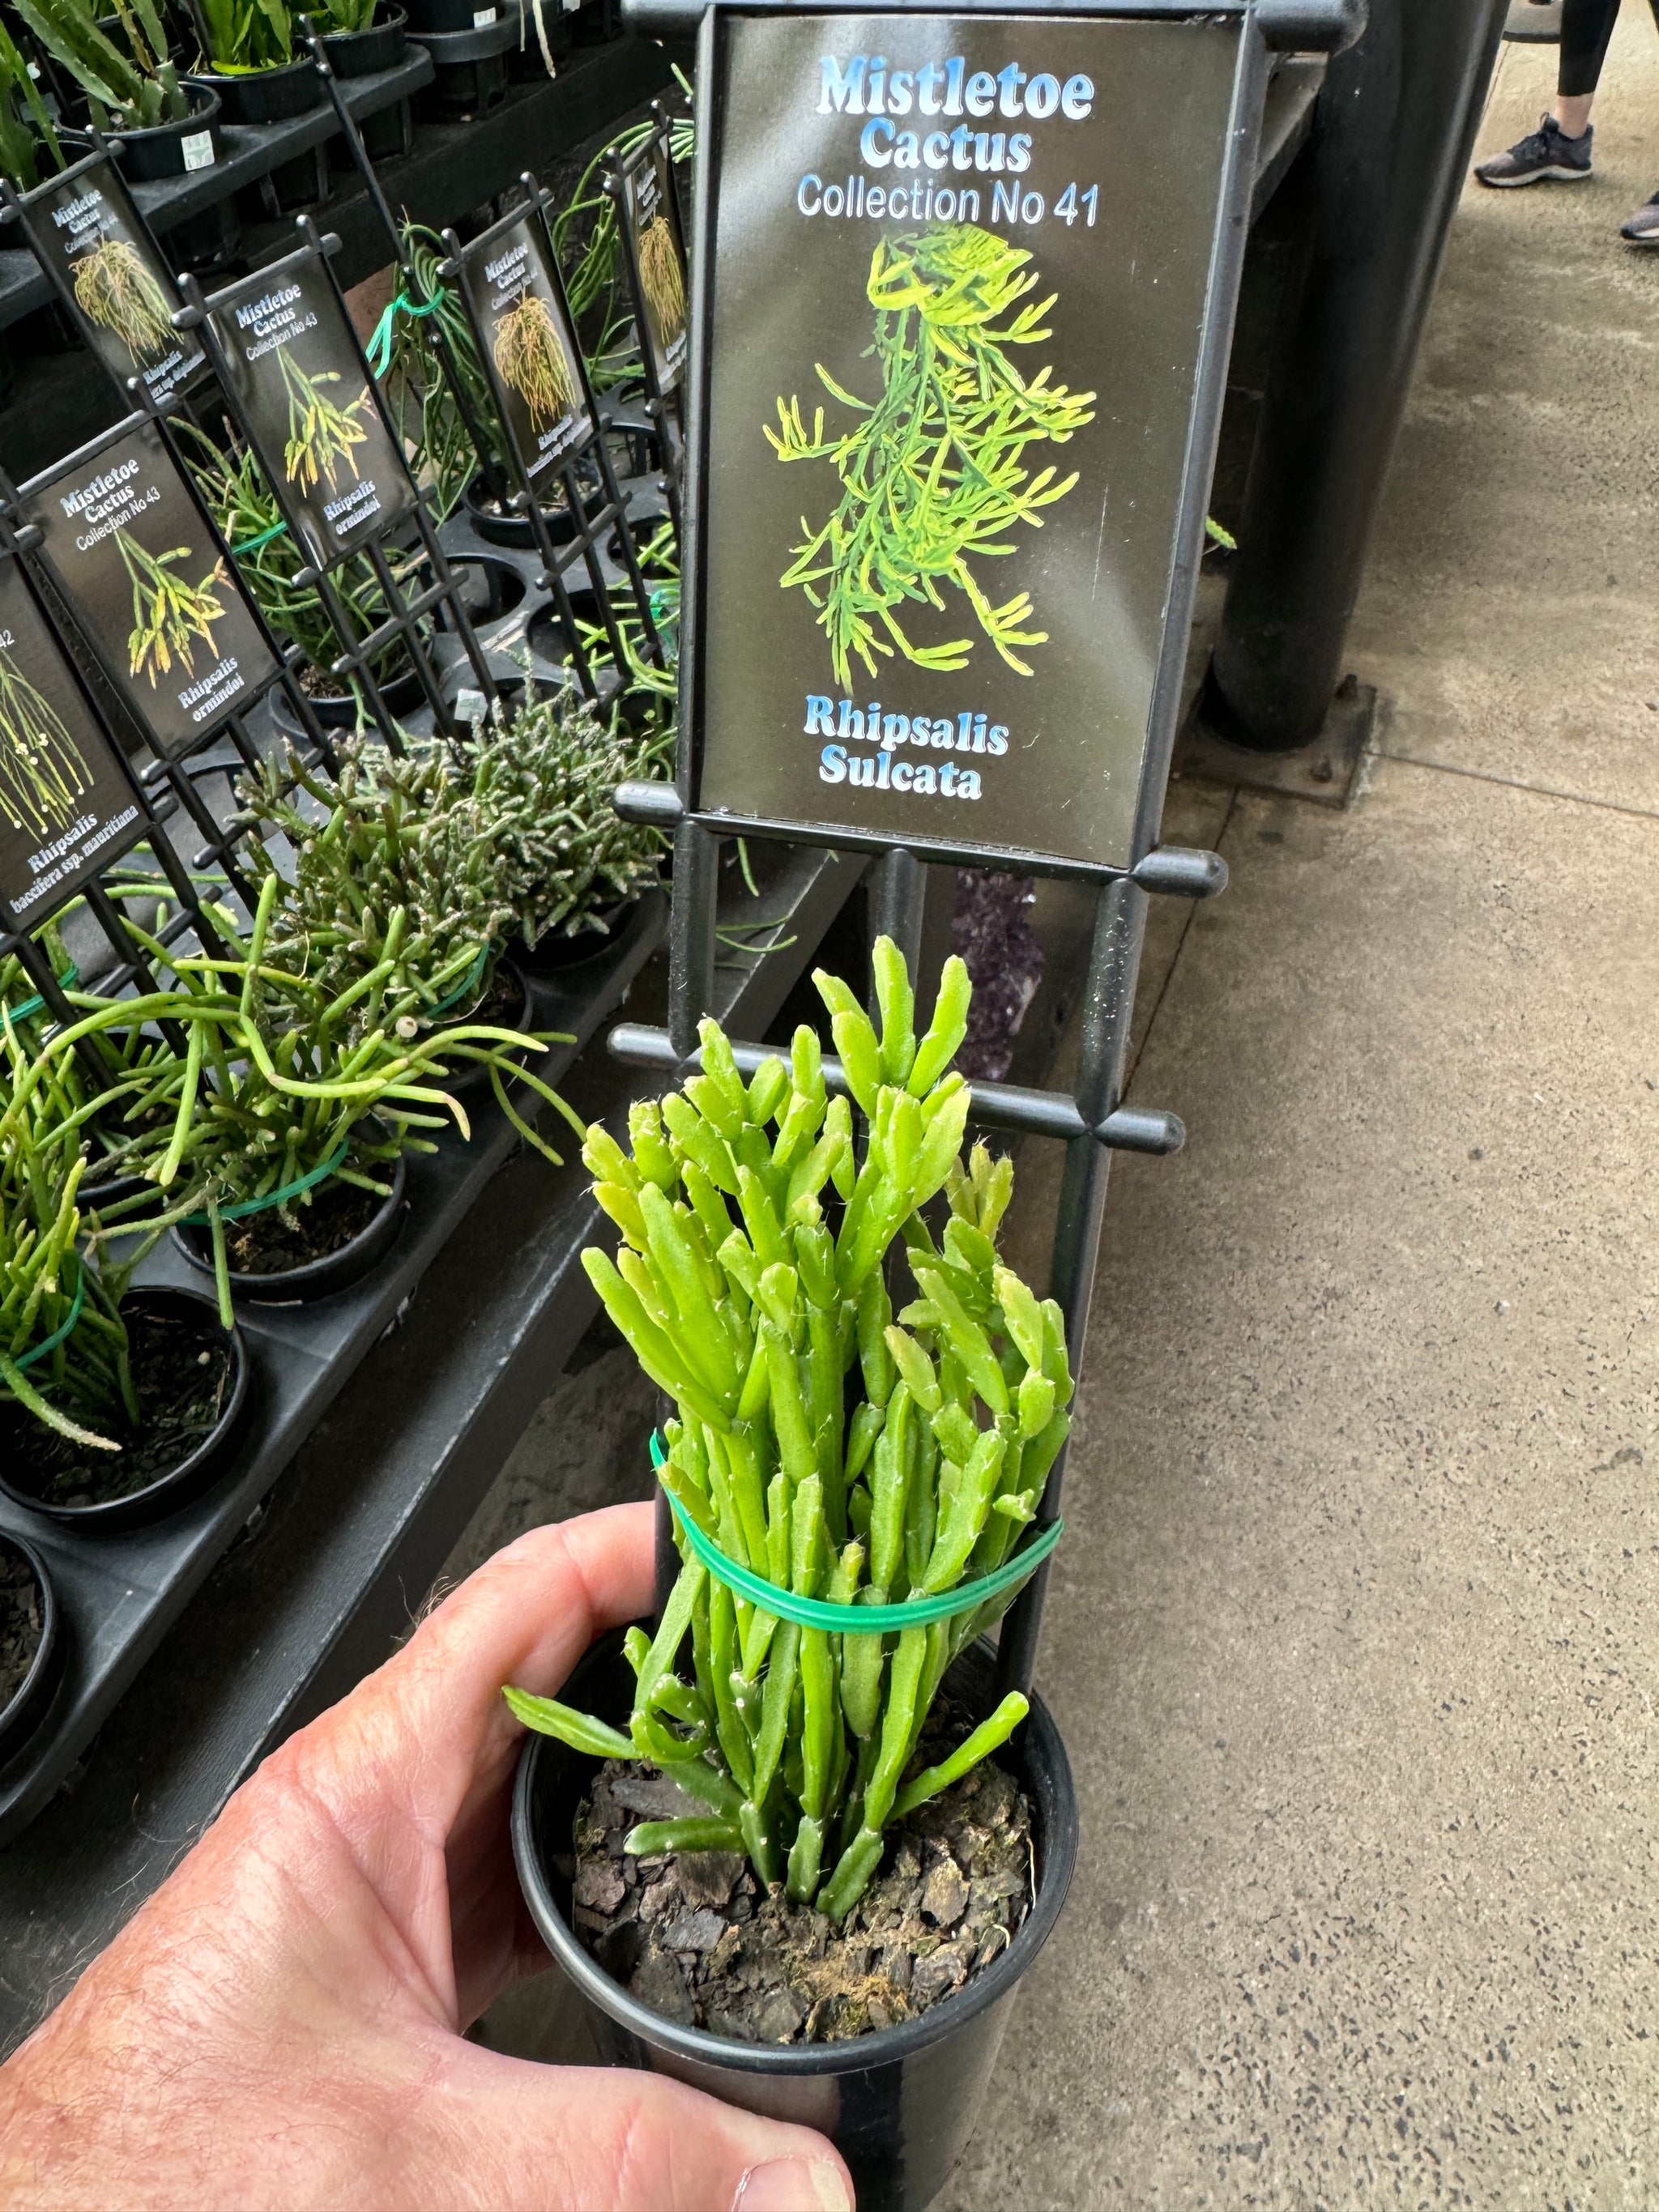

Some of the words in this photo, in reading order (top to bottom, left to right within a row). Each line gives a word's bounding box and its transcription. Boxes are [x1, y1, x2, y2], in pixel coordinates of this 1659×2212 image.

[816, 55, 1095, 120] Mistletoe
[860, 117, 1033, 173] Cactus
[797, 173, 980, 222] Collection
[991, 179, 1045, 224] No
[1052, 181, 1099, 227] 41
[235, 284, 302, 329] Mistletoe
[254, 307, 296, 337] Cactus
[59, 458, 139, 518] Mistletoe
[84, 485, 135, 523] Cactus
[322, 479, 376, 521] Rhipsalis
[75, 509, 131, 551] Collection
[128, 498, 147, 516] No
[146, 486, 161, 503] 43
[177, 657, 238, 710] Rhipsalis
[804, 694, 1009, 756] Rhipsalis
[819, 744, 983, 800] Sulcata
[27, 813, 98, 874] Rhipsalis
[61, 853, 84, 875] ssp.
